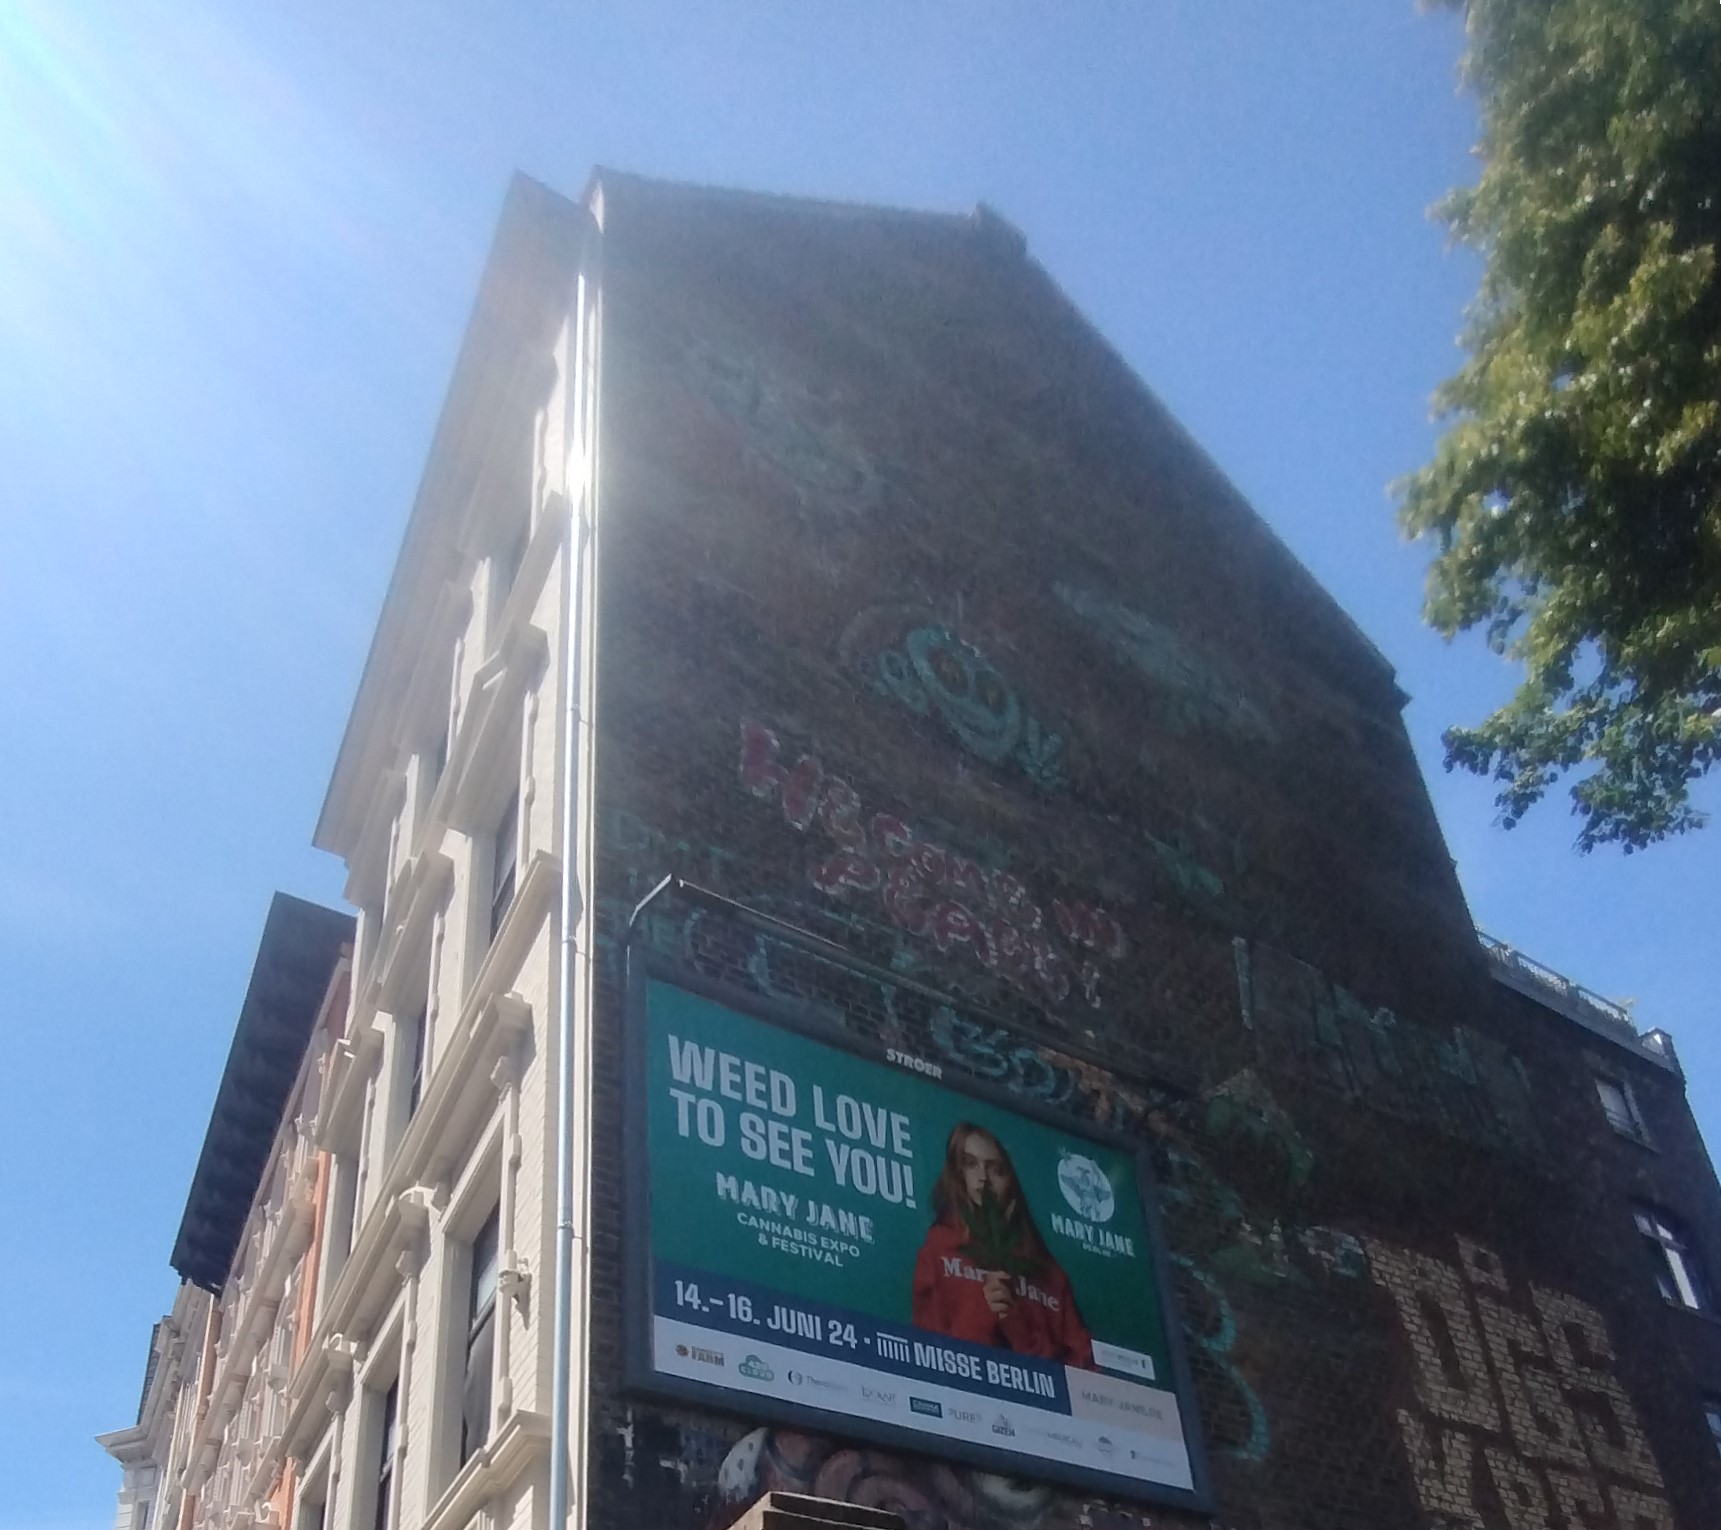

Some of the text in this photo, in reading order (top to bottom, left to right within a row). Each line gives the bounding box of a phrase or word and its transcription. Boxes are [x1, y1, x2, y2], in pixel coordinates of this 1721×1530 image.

[668, 1034, 913, 1158] WEED LOVE
[669, 1088, 917, 1209] TO SEE YOU!
[716, 1172, 875, 1245] MARY JANE
[737, 1212, 861, 1258] CANNABIS EXPO
[758, 1233, 844, 1267] & FESTIVAL
[1051, 1213, 1136, 1258] MARY JANE
[941, 1256, 1060, 1312] Mar Jane
[767, 1305, 822, 1341] JUNI
[828, 1319, 858, 1349] 24
[986, 1360, 1056, 1399] BERLIN
